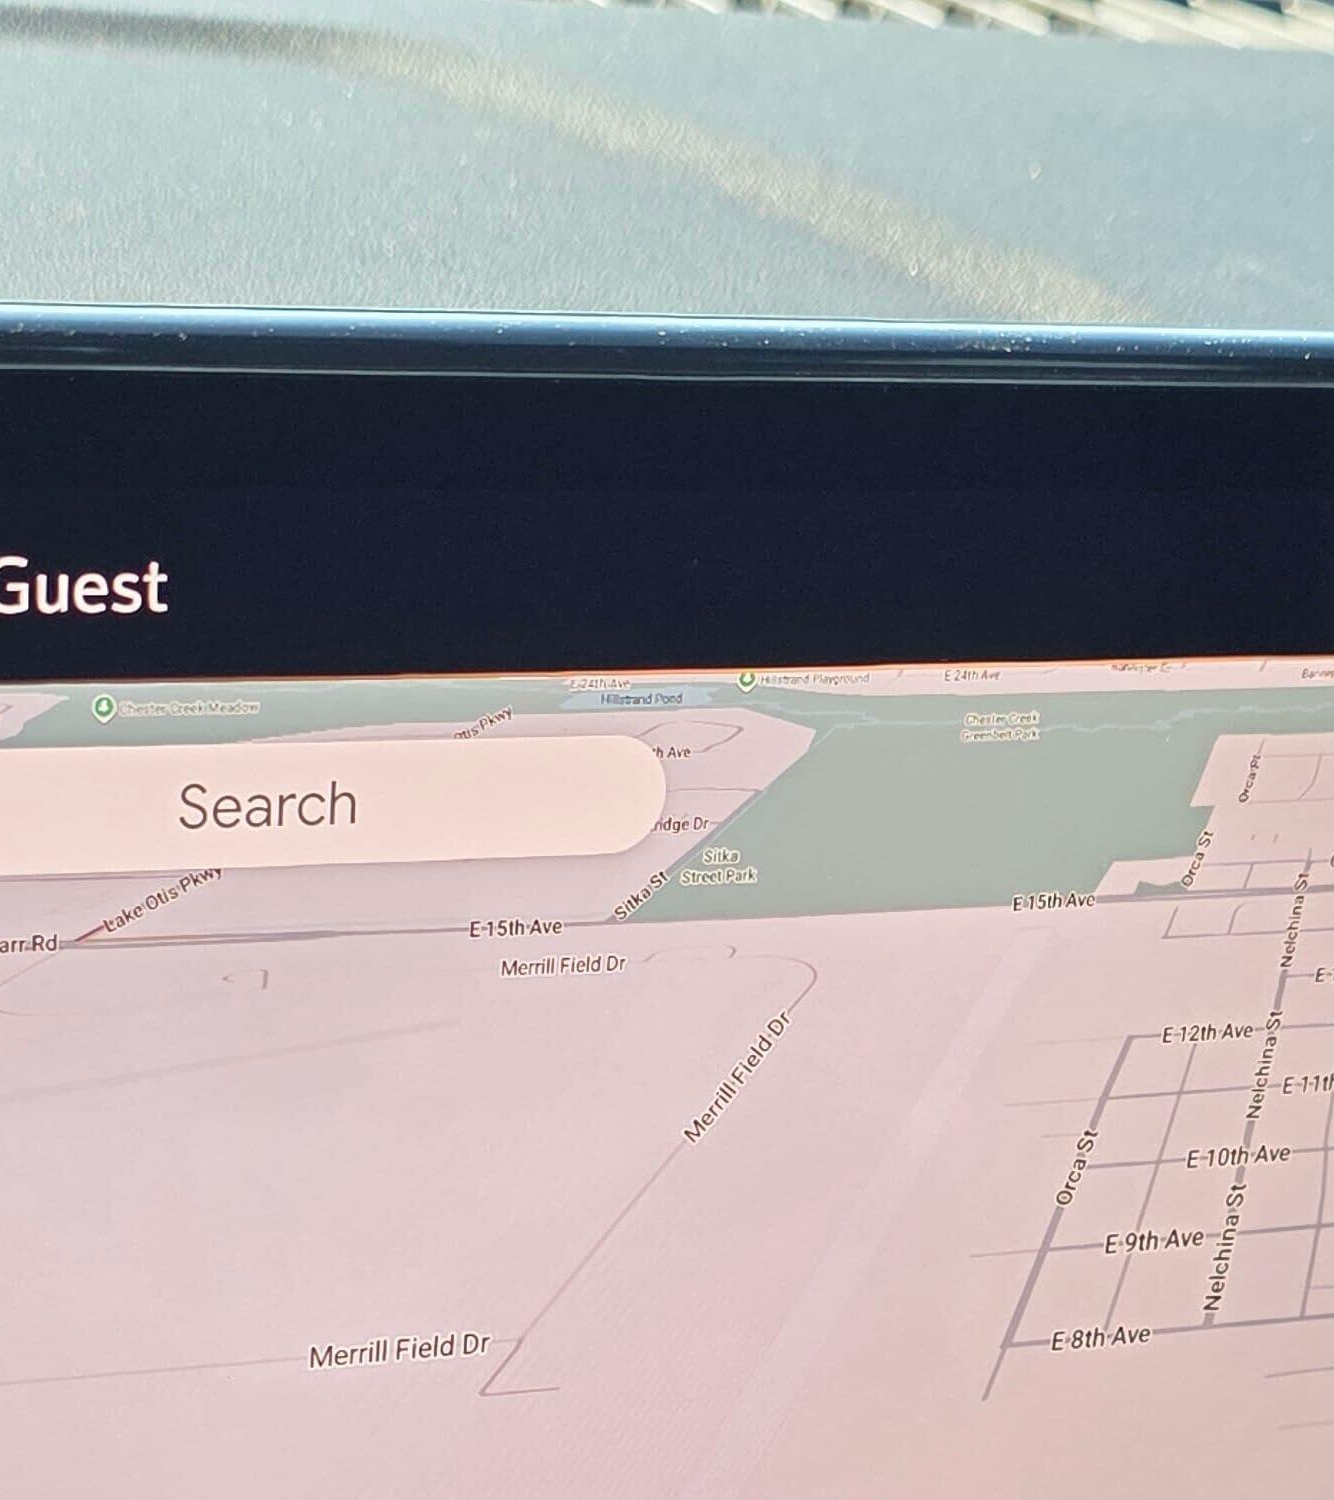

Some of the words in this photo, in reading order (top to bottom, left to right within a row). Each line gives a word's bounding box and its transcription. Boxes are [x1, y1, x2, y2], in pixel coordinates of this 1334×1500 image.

[944, 671, 952, 682] E
[953, 670, 978, 681] 24th
[980, 670, 1001, 680] Ave
[170, 702, 204, 715] Creek
[208, 700, 259, 715] Meadow
[654, 692, 683, 704] Pond
[478, 705, 514, 732] Pkwy
[667, 746, 691, 759] Ave
[177, 781, 357, 830] Search
[651, 816, 689, 834] ridge
[693, 816, 709, 831] Dr
[703, 848, 739, 864] Sitka
[1181, 850, 1206, 888] Orca
[1198, 830, 1214, 850] St
[681, 870, 722, 885] Street
[725, 868, 757, 883] Park
[613, 886, 655, 921] Sitka
[650, 871, 668, 890] St
[1013, 894, 1024, 911] E
[1029, 892, 1063, 910] 15th
[1066, 891, 1096, 908] Ave
[103, 903, 144, 933] Lake
[145, 886, 180, 911] Otis
[1280, 894, 1305, 968] Nelchina
[1294, 872, 1310, 891] St
[469, 920, 482, 938] E
[486, 919, 525, 937] 15th
[530, 918, 564, 935] Ave
[31, 933, 58, 952] Rd
[501, 956, 556, 977] Merrill
[560, 955, 601, 974] Field
[605, 954, 627, 972] Dr
[1315, 967, 1325, 982] E
[1162, 1027, 1173, 1043] E
[1178, 1025, 1218, 1042] 12th
[1221, 1024, 1253, 1040] Ave
[1246, 1032, 1277, 1119] Nelchina
[1266, 1009, 1284, 1031] St
[682, 1080, 737, 1144] Merrill
[730, 1038, 773, 1088] Field
[766, 1010, 791, 1042] Dr
[1282, 1077, 1294, 1094] E
[1056, 1157, 1086, 1206] Orca
[1077, 1130, 1099, 1153] St
[1187, 1151, 1199, 1169] E
[1205, 1148, 1249, 1167] 10th
[1254, 1146, 1291, 1164] Ave
[1105, 1235, 1119, 1254] E
[1123, 1232, 1159, 1252] 9th
[1163, 1230, 1204, 1249] Ave
[1202, 1212, 1240, 1311] Nelchina
[1225, 1182, 1246, 1207] St
[1051, 1331, 1066, 1351] E
[1070, 1328, 1107, 1349] 8th
[1111, 1326, 1151, 1346] Ave
[308, 1340, 389, 1370] Merrill
[395, 1335, 455, 1364] Field
[462, 1334, 490, 1358] Dr
